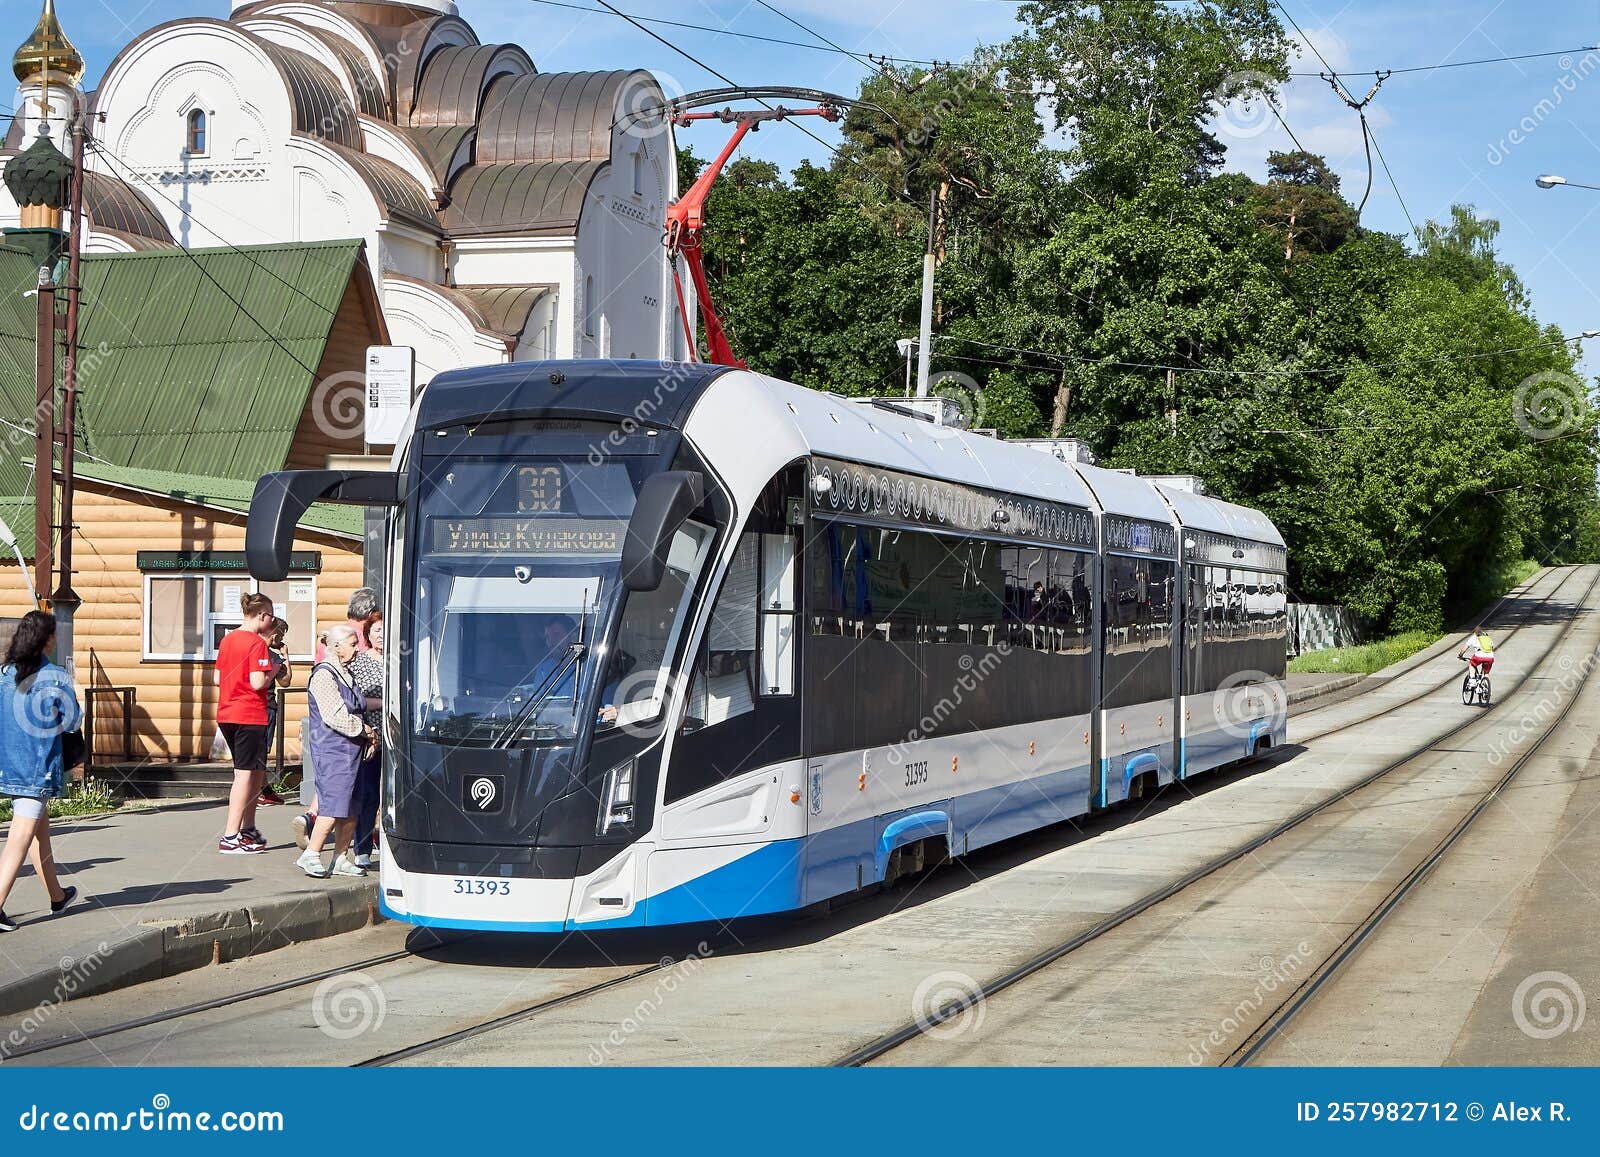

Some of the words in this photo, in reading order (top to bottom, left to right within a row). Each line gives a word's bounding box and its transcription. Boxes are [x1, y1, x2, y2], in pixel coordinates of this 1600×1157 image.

[518, 467, 561, 511] 30
[448, 523, 511, 549] Улица
[904, 761, 929, 787] 31393
[453, 879, 512, 896] 31393
